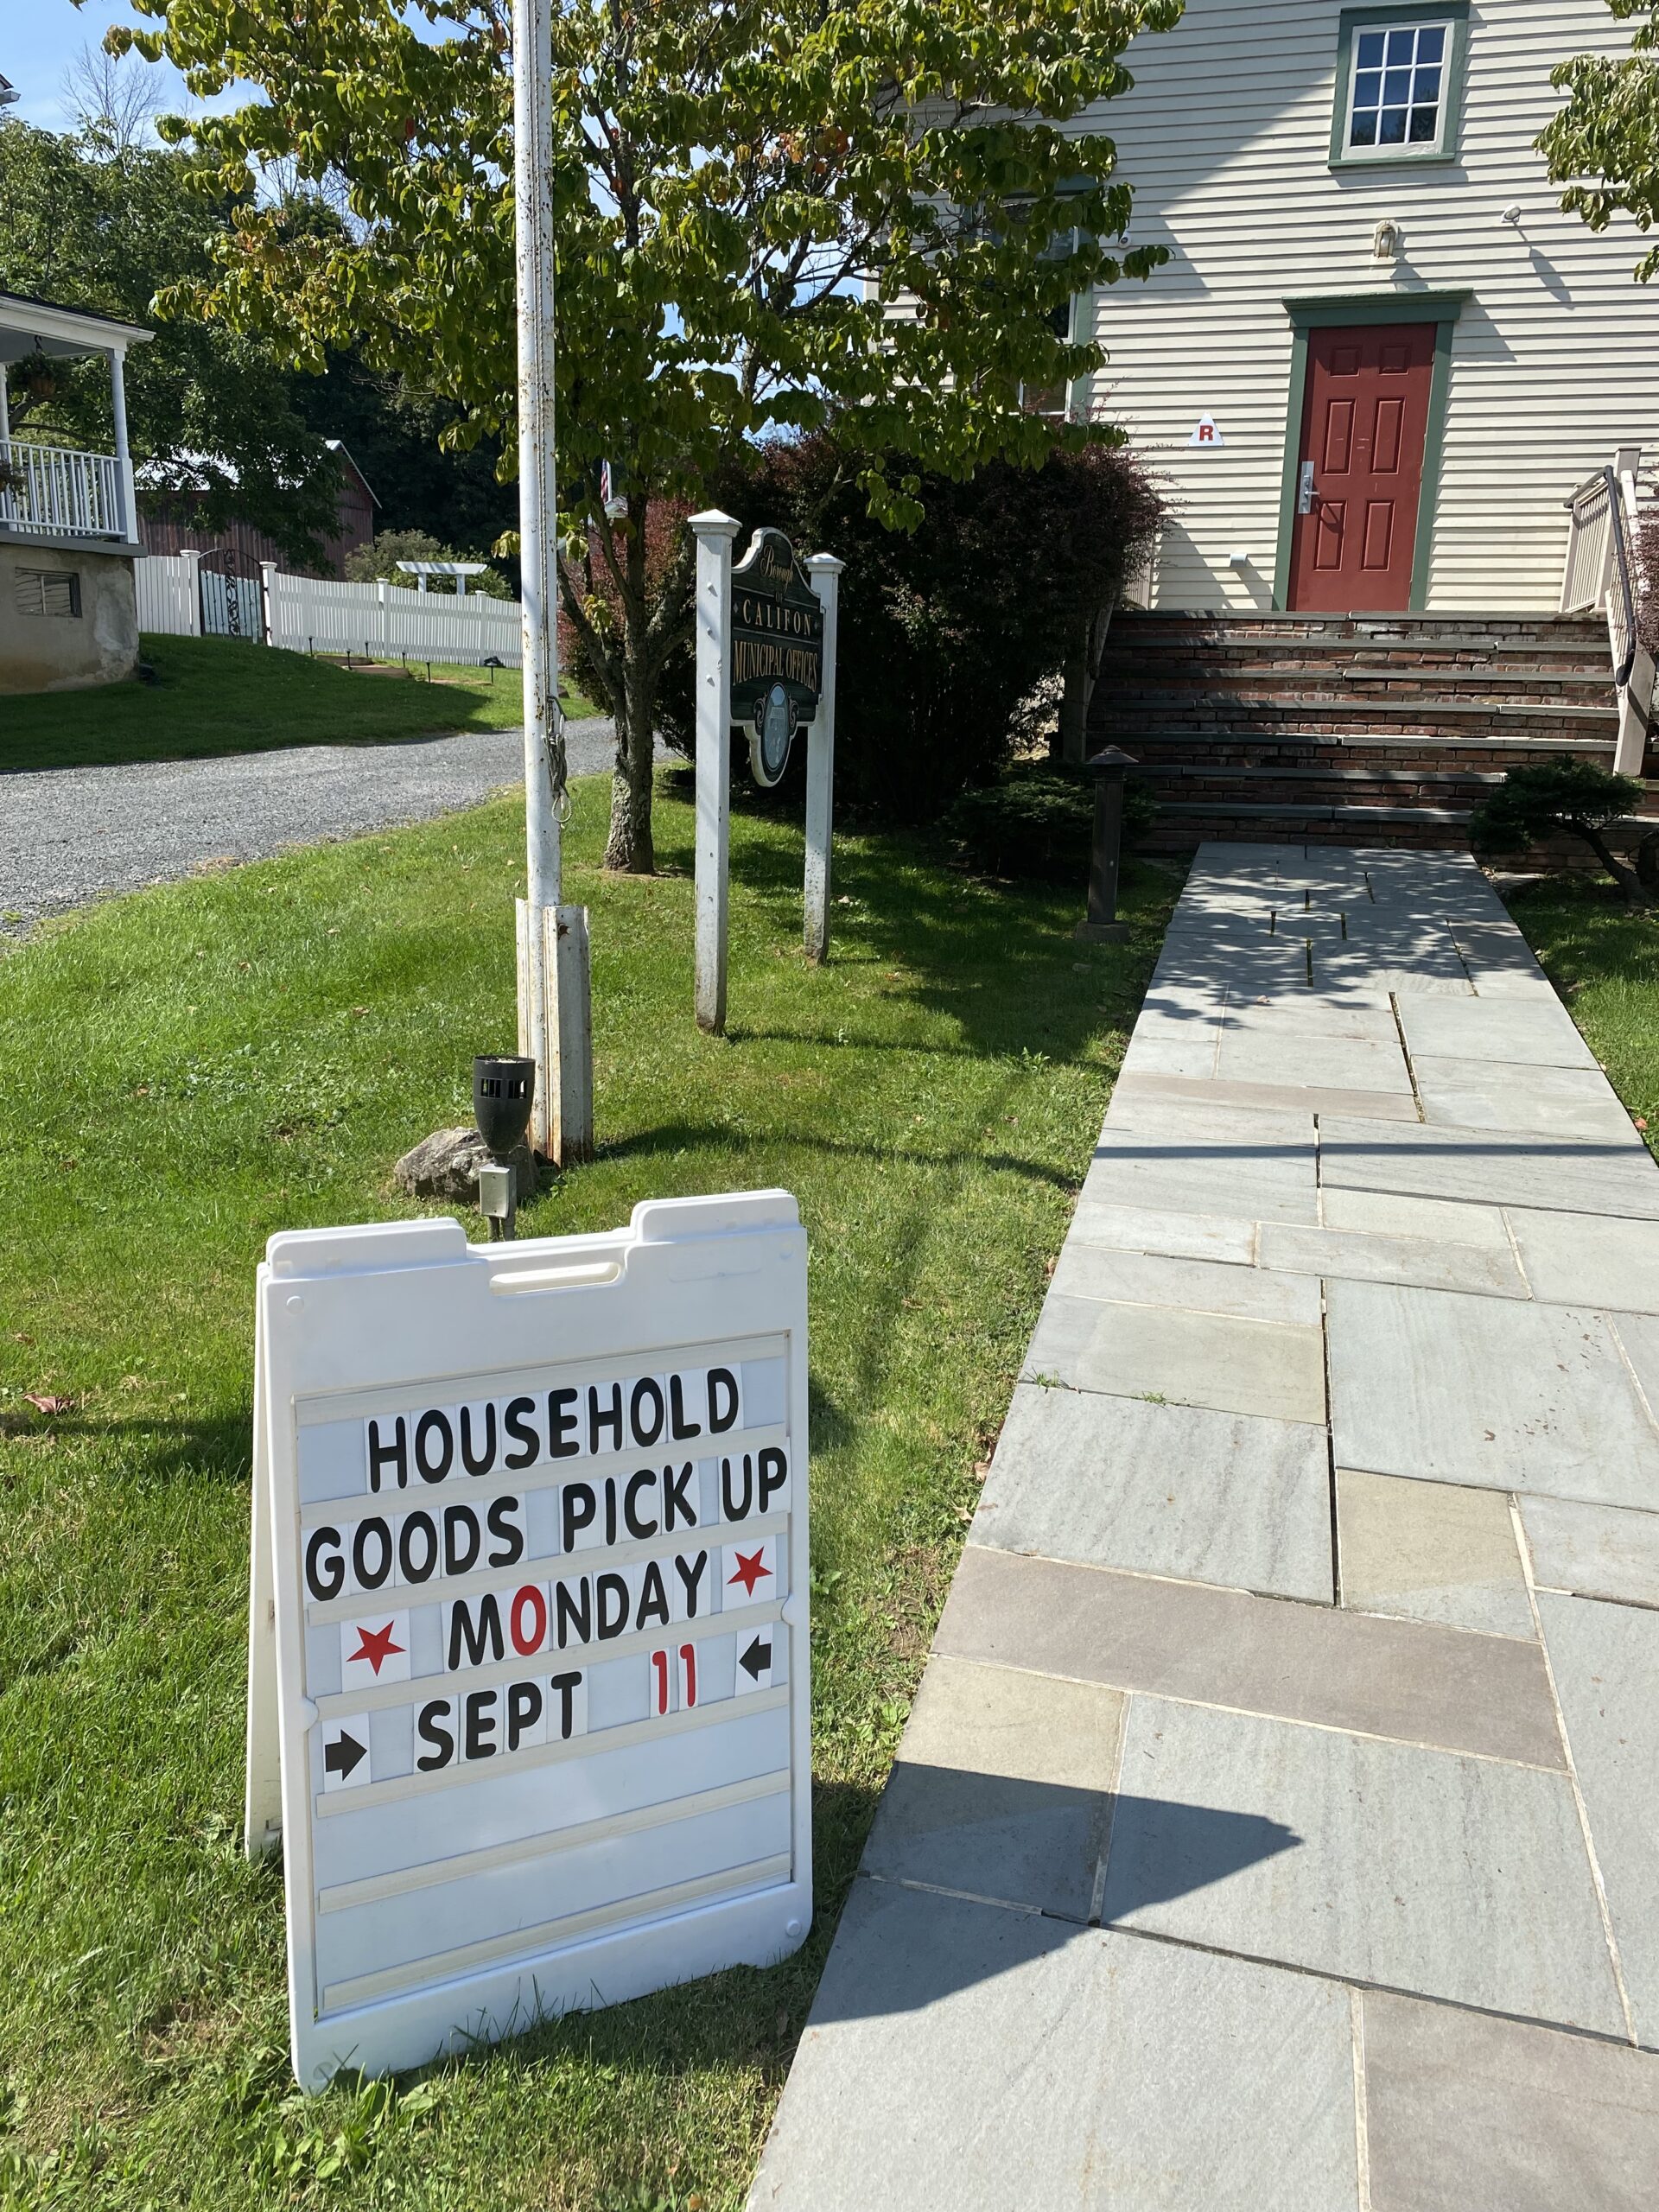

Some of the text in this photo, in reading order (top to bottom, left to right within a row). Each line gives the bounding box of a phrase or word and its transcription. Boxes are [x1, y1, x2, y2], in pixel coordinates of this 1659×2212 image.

[1199, 425, 1214, 442] R
[761, 544, 793, 594] Borough
[743, 599, 810, 637] CALIFON
[733, 640, 817, 693] MUNICIPAL OFFICES
[369, 1368, 739, 1493] HOUSEHOLD
[306, 1447, 787, 1601] GOODS PICK UP
[448, 1551, 707, 1671] MONDAY
[417, 1644, 696, 1771] SEPT 11
